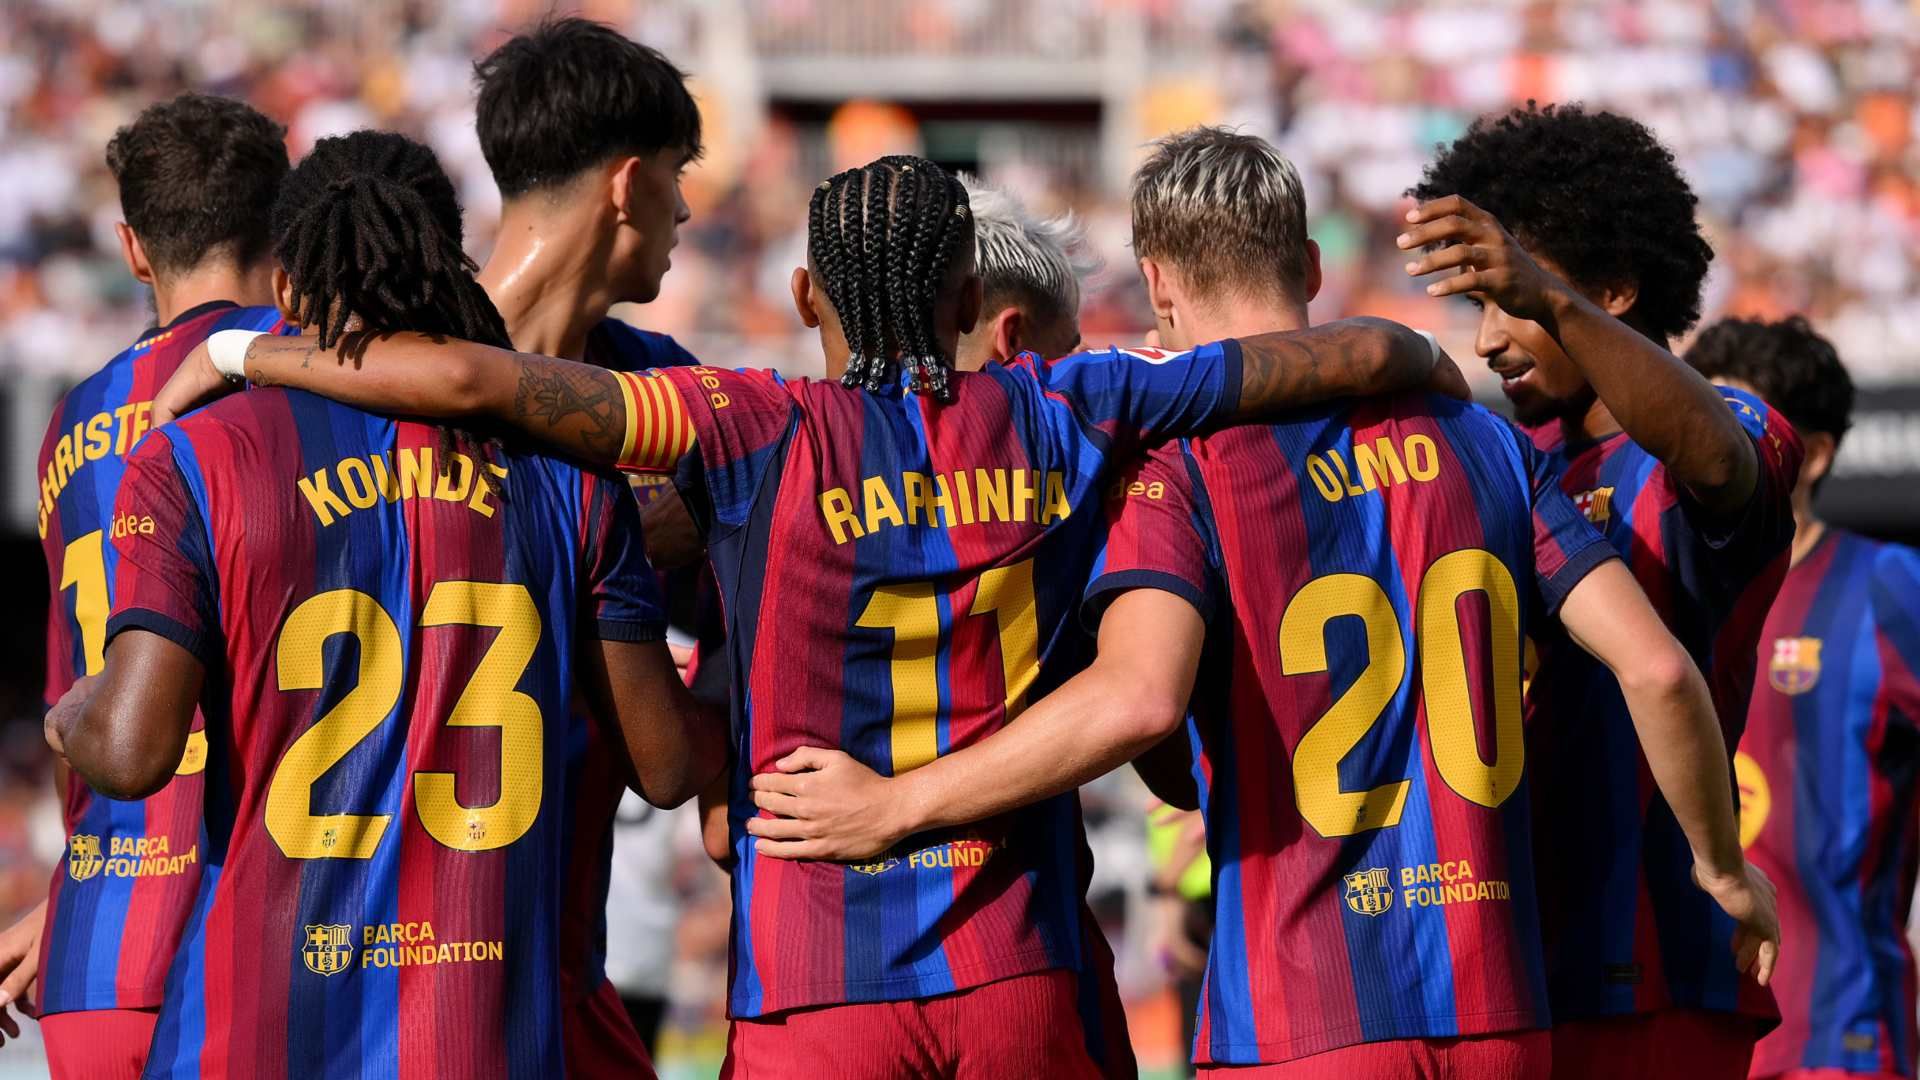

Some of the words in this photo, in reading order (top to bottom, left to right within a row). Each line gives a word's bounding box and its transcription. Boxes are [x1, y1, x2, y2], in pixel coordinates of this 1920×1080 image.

[297, 447, 508, 527] KOUNDE
[1306, 433, 1440, 502] OLMO
[817, 468, 1072, 545] RAPHINHA
[854, 556, 1040, 778] 11
[1279, 548, 1525, 838] 20
[264, 578, 544, 860] 23
[110, 836, 169, 860] BARÇA
[1401, 860, 1473, 886] BARÇA
[362, 941, 503, 969] FOUNDATION
[363, 921, 435, 946] BARÇA
